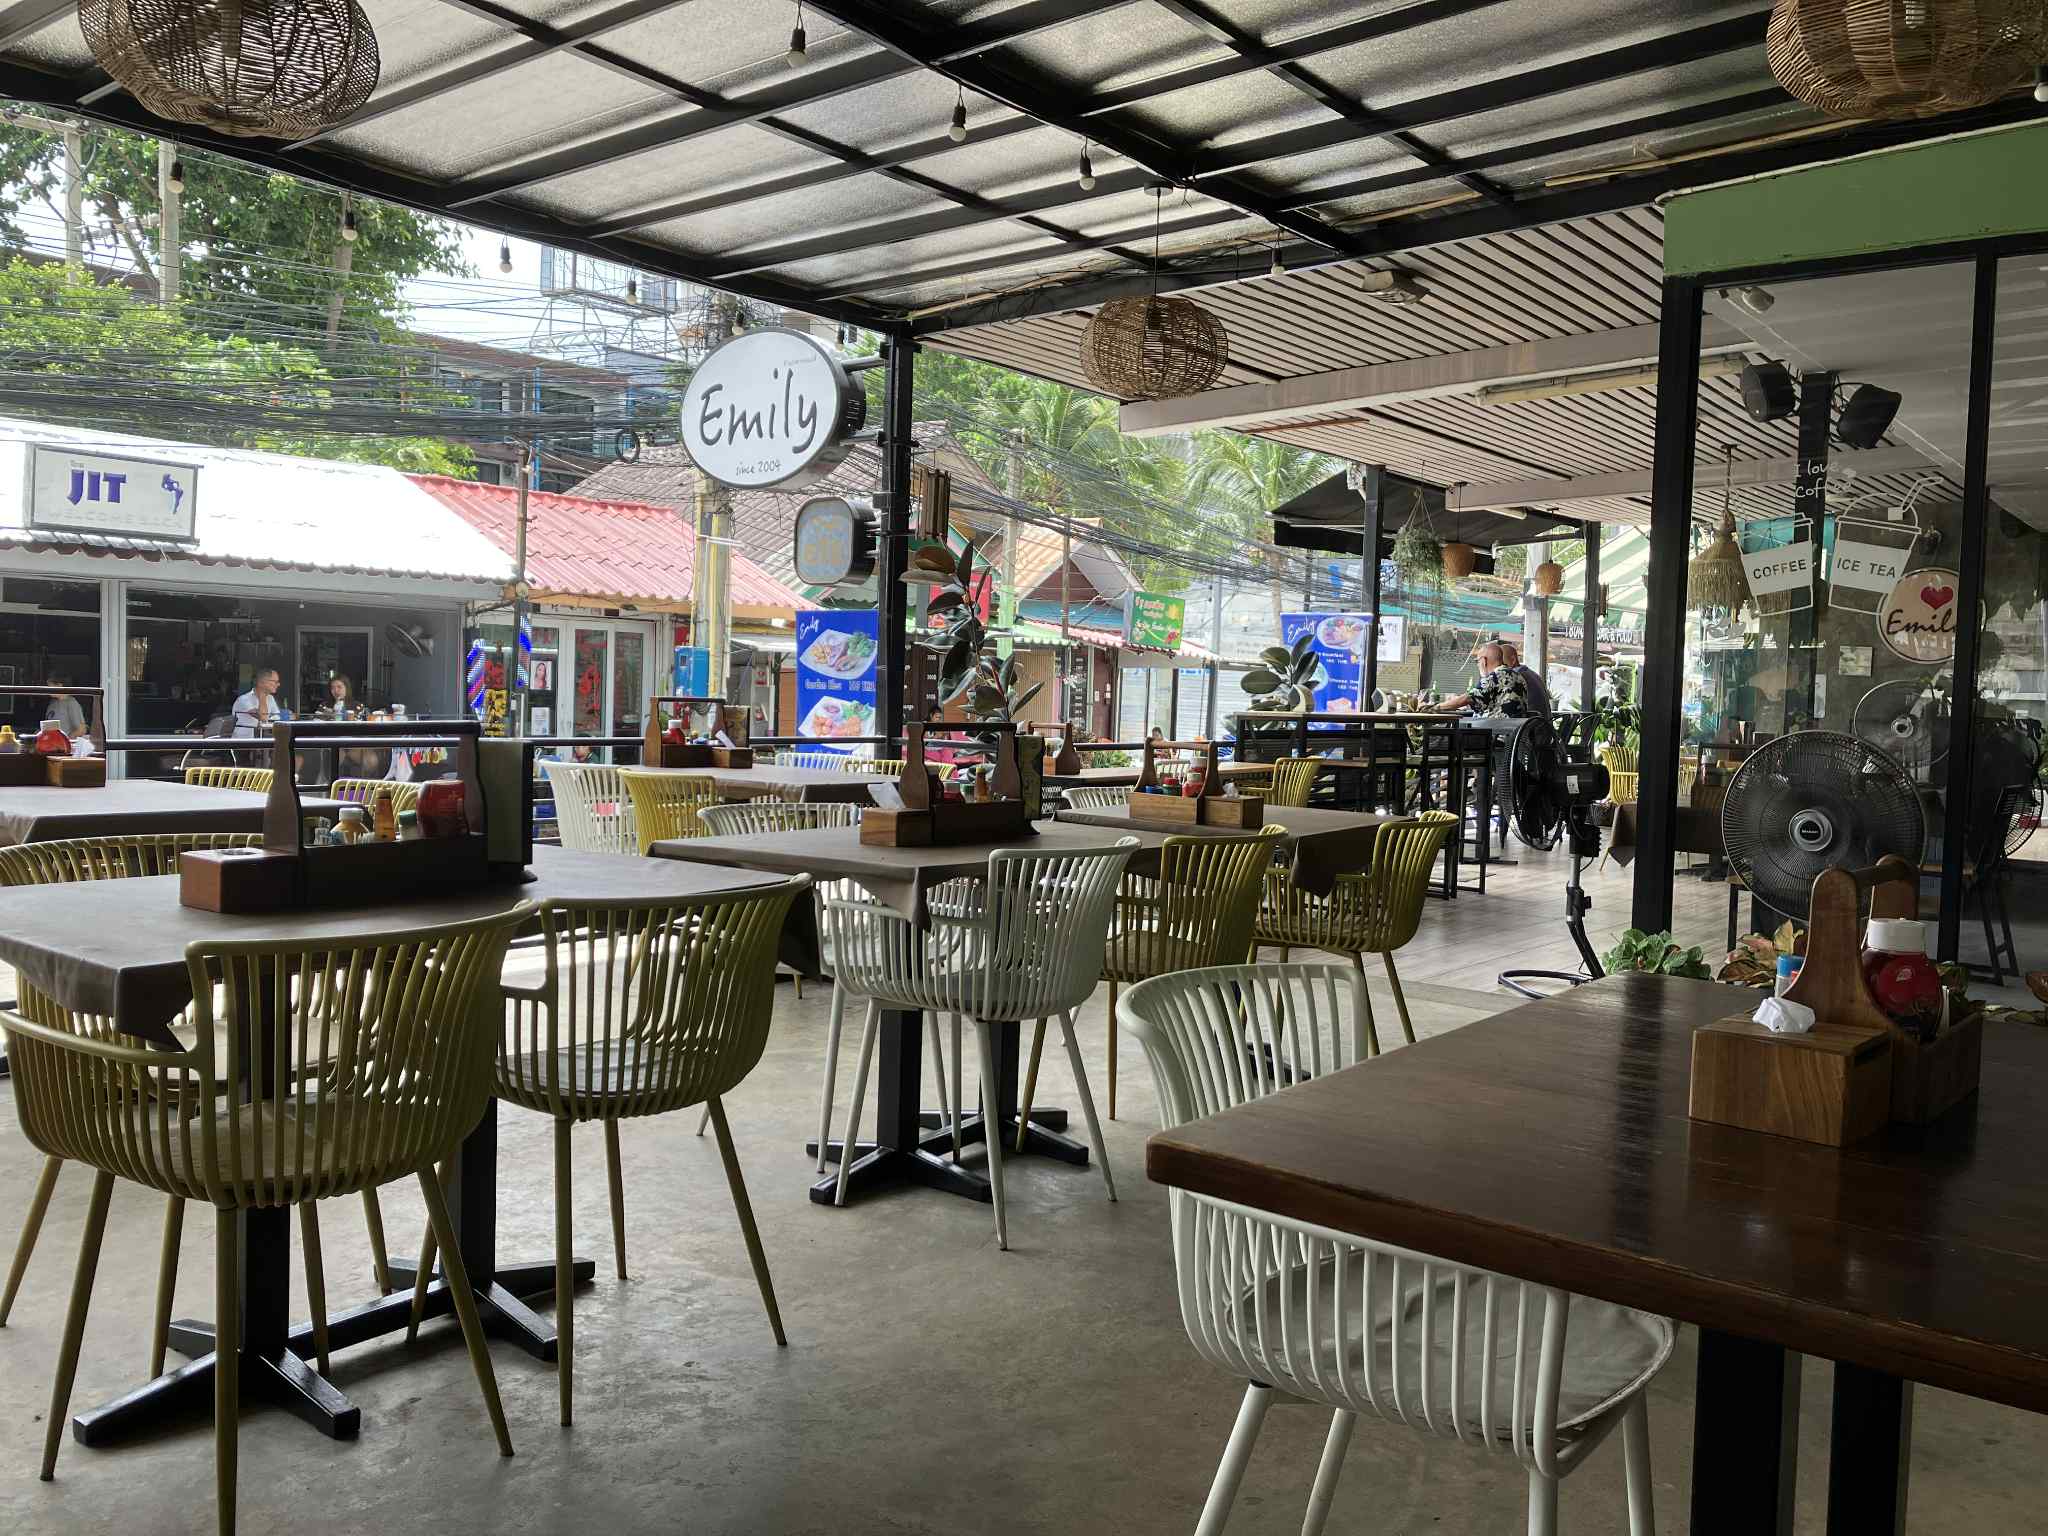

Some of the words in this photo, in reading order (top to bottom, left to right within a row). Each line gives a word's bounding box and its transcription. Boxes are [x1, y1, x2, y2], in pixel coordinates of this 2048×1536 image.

[700, 367, 818, 454] Emily
[1807, 459, 1840, 476] love
[1753, 558, 1807, 579] COFFEE
[1837, 557, 1860, 572] ICE
[1869, 562, 1896, 578] TEA
[799, 616, 820, 640] Emily
[1287, 616, 1316, 642] Emily
